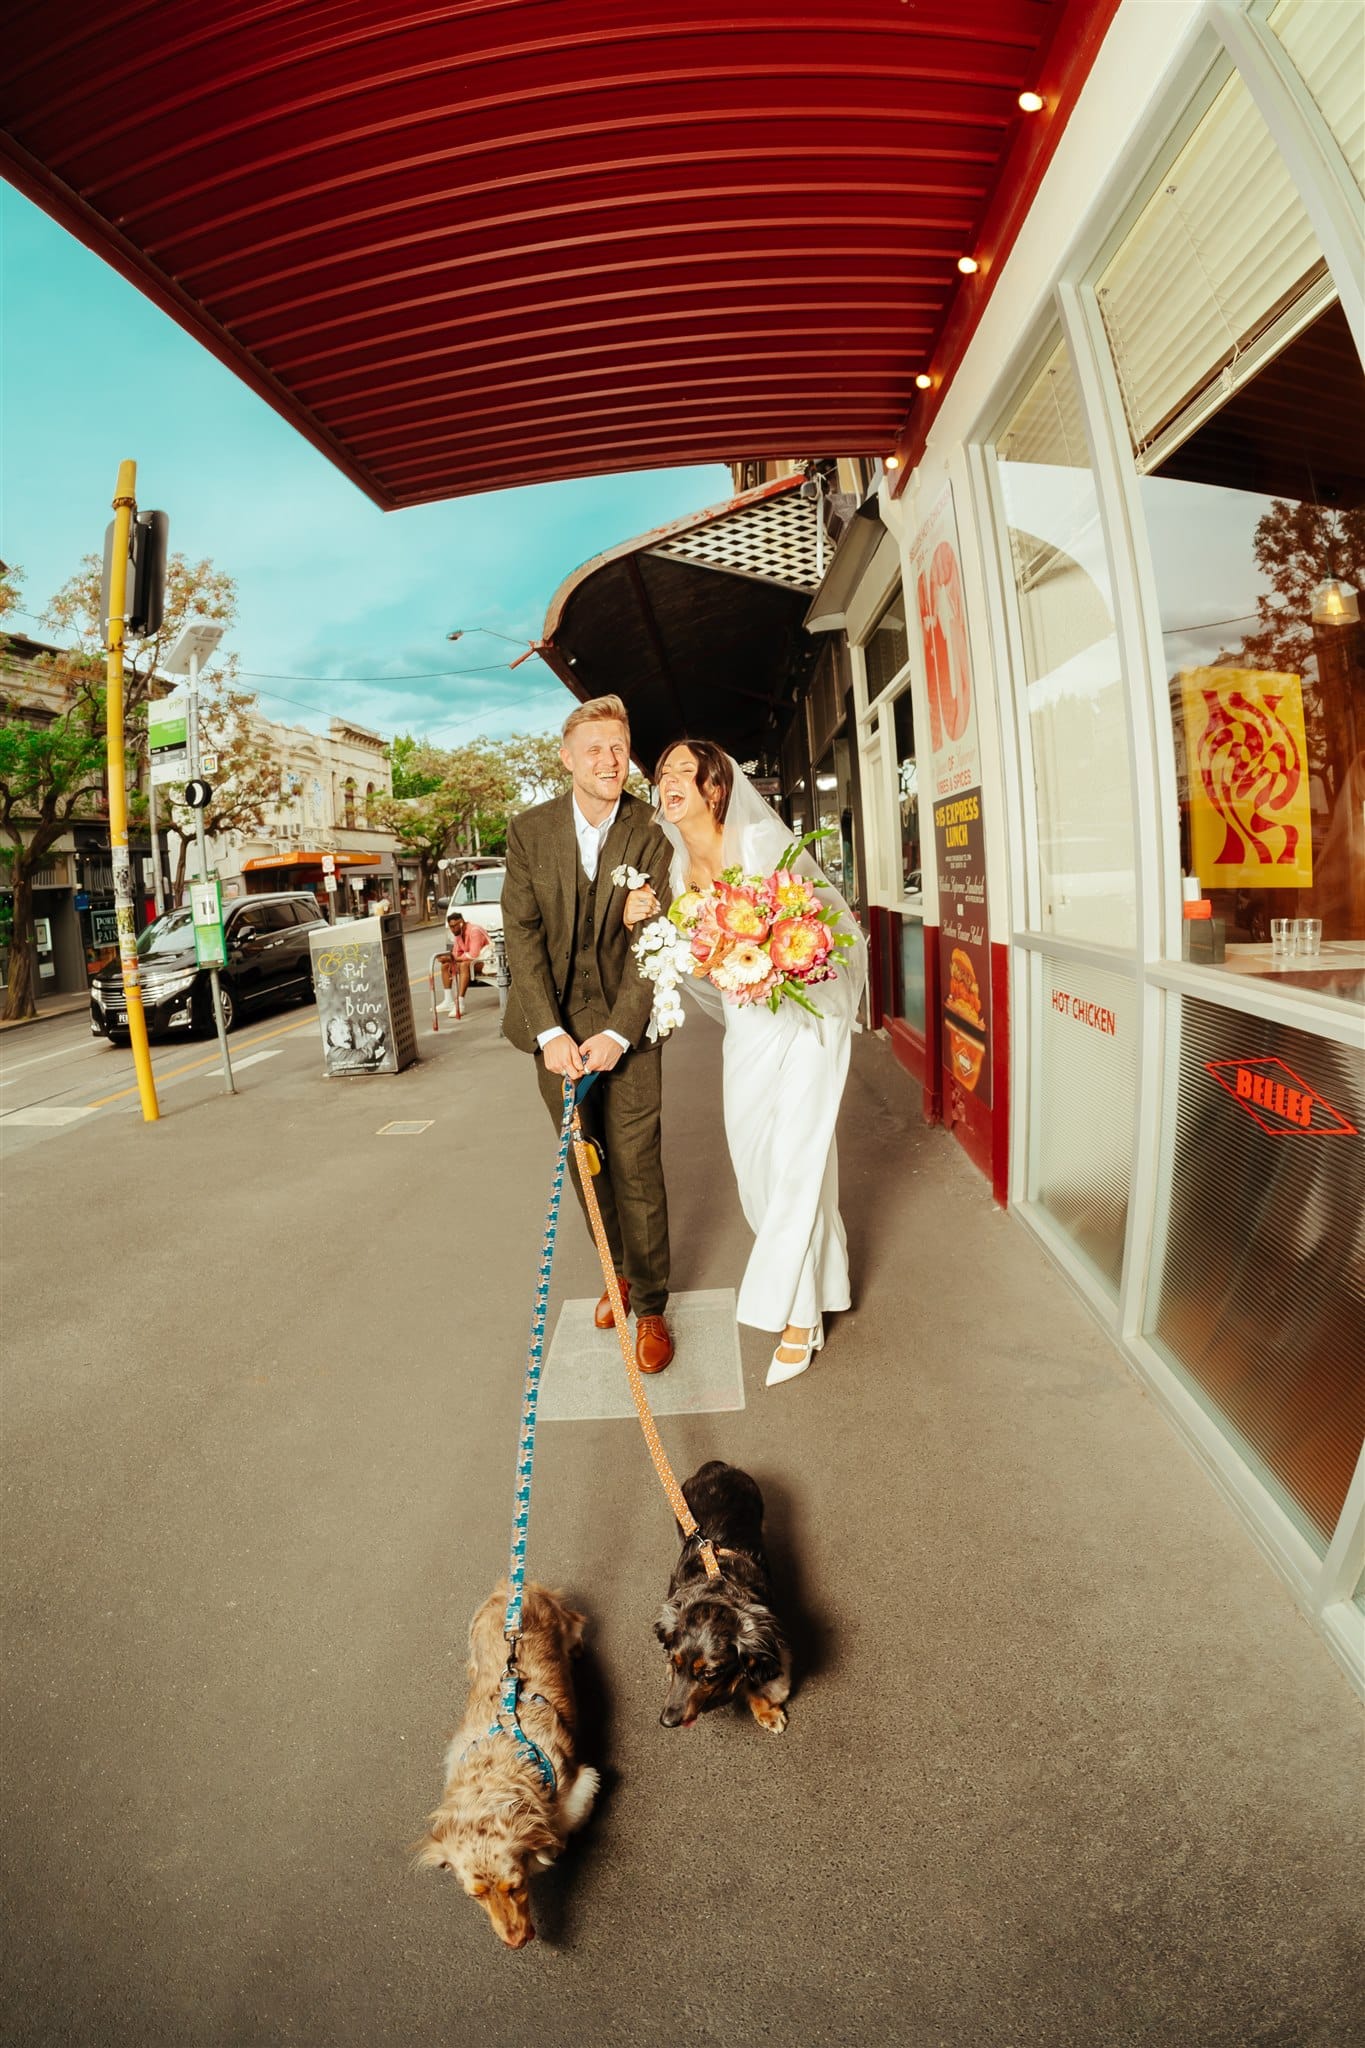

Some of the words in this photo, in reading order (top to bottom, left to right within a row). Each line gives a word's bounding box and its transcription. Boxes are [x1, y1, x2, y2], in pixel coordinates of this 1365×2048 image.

[945, 796, 979, 825] EXPRESS
[946, 824, 968, 848] LUNCH
[1051, 989, 1070, 1015] HOT
[1072, 997, 1116, 1036] CHICKEN
[1236, 1067, 1313, 1127] BELLES
